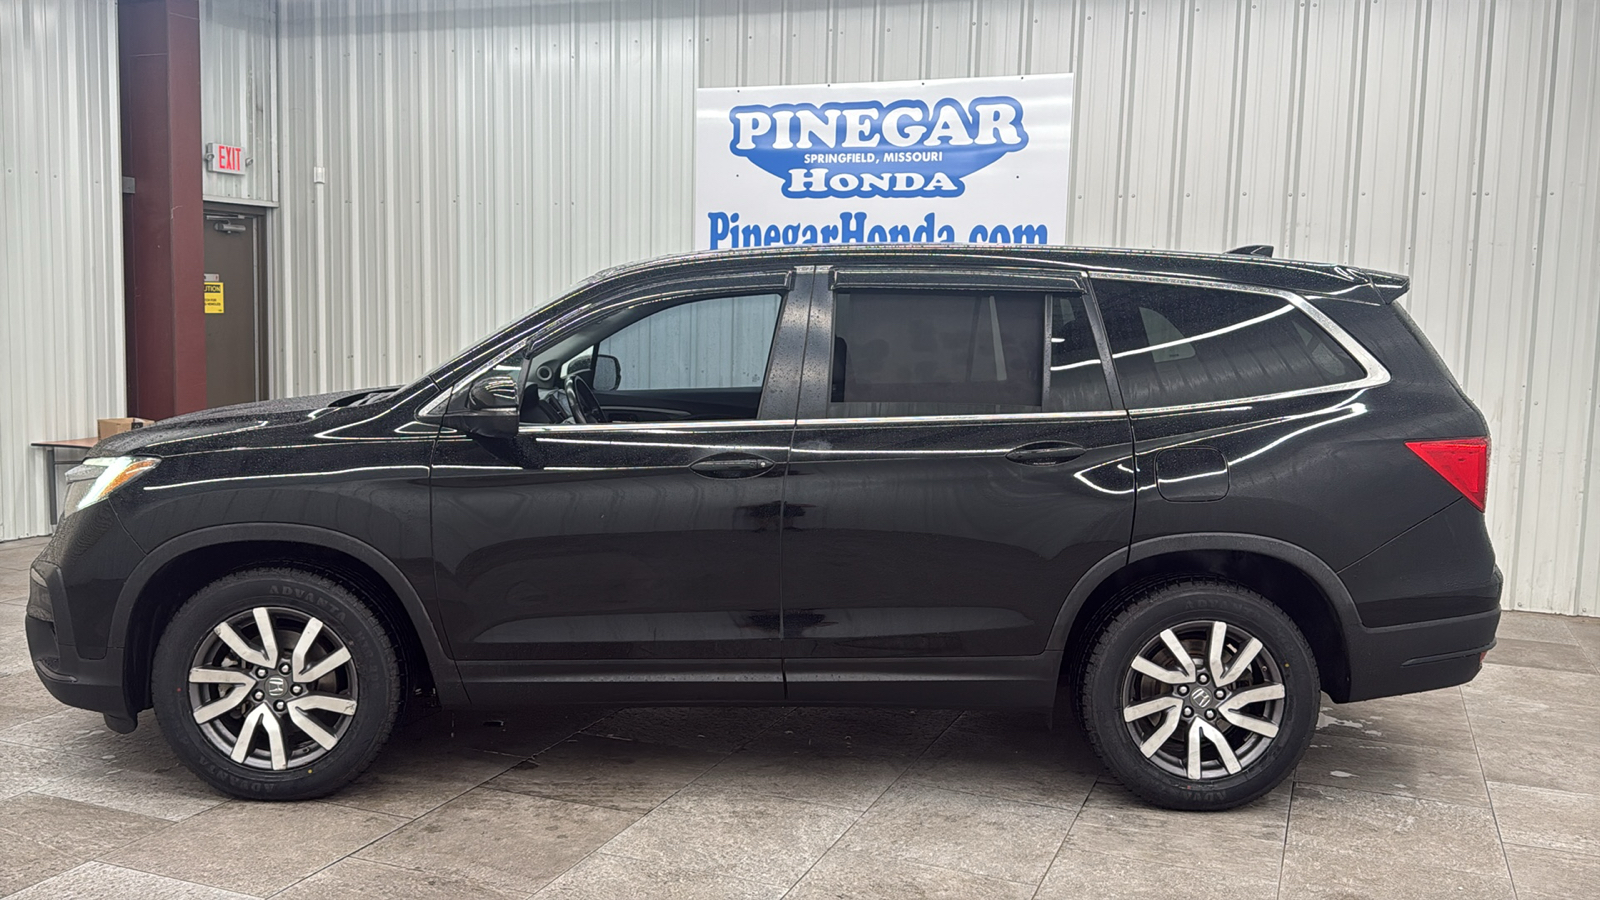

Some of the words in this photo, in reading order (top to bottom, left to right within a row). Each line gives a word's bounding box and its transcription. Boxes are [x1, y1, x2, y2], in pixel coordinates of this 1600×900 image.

[735, 103, 1022, 150] PINEGAR
[218, 145, 242, 171] EXIT
[804, 153, 880, 164] SPRINGFIELD,
[883, 151, 943, 163] MISSOURI
[787, 167, 958, 192] HONDA
[707, 211, 1049, 250] PinegarHondacom
[268, 584, 348, 624] ADVANTA
